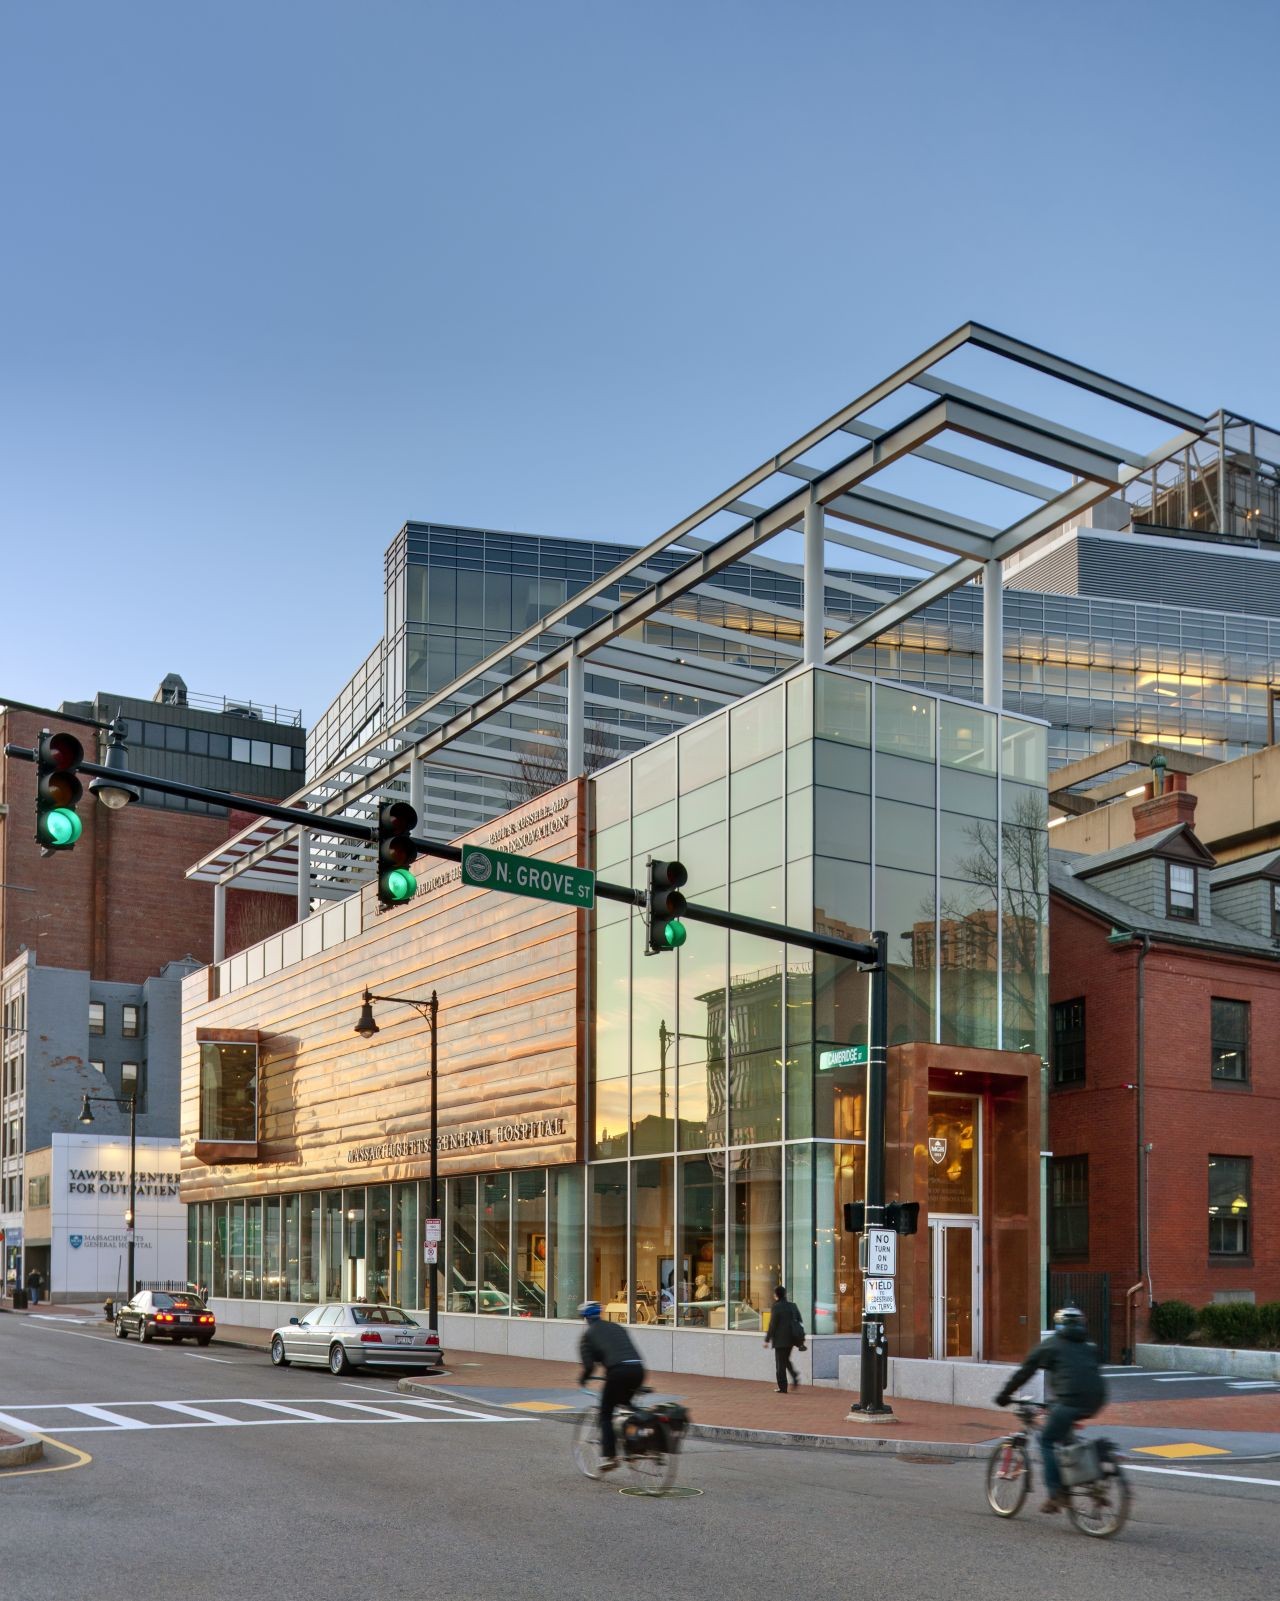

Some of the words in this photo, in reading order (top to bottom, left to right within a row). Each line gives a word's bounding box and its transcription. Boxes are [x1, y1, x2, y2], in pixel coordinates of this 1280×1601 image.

[496, 861, 512, 884] N.
[516, 866, 574, 896] GROVE
[577, 884, 591, 899] ST
[347, 1137, 431, 1163] MASSACHUSETTS
[496, 1118, 566, 1142] HOSPITAL
[69, 1169, 126, 1182] YAWKEY
[69, 1183, 96, 1194] FOR
[100, 1183, 181, 1196] OUTATIEN
[876, 1234, 889, 1244] NO
[84, 1241, 118, 1249] GENERAL
[118, 1241, 152, 1249] HOPITAL
[874, 1245, 891, 1253] TURN
[840, 1255, 847, 1266] 2
[877, 1254, 887, 1262] ON
[876, 1263, 888, 1271] RED
[868, 1281, 892, 1290] YIELD
